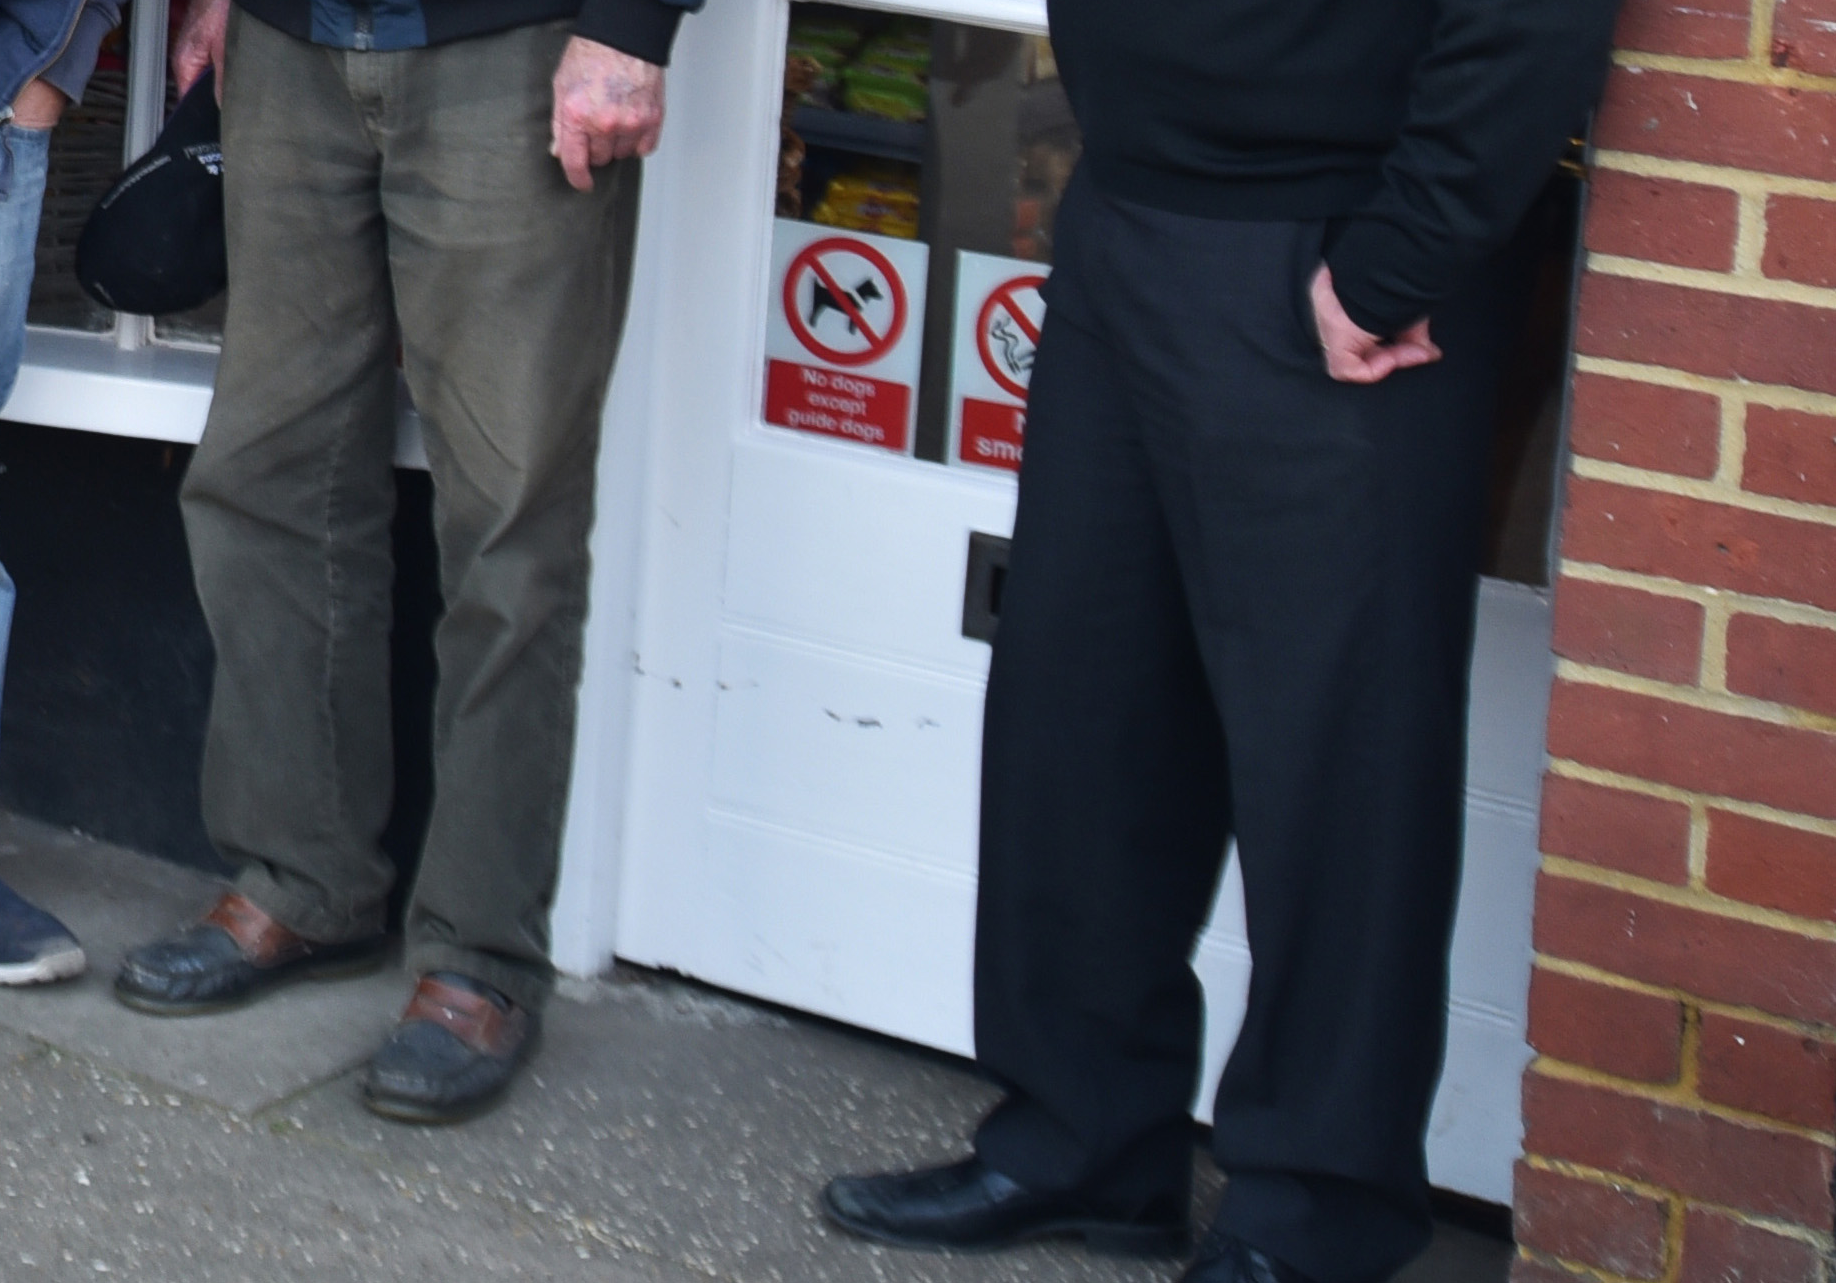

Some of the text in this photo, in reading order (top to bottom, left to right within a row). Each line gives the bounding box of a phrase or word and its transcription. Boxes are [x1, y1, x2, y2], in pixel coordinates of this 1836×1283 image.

[801, 367, 876, 397] No dogs
[807, 389, 867, 418] except
[787, 407, 885, 443] guide dogs
